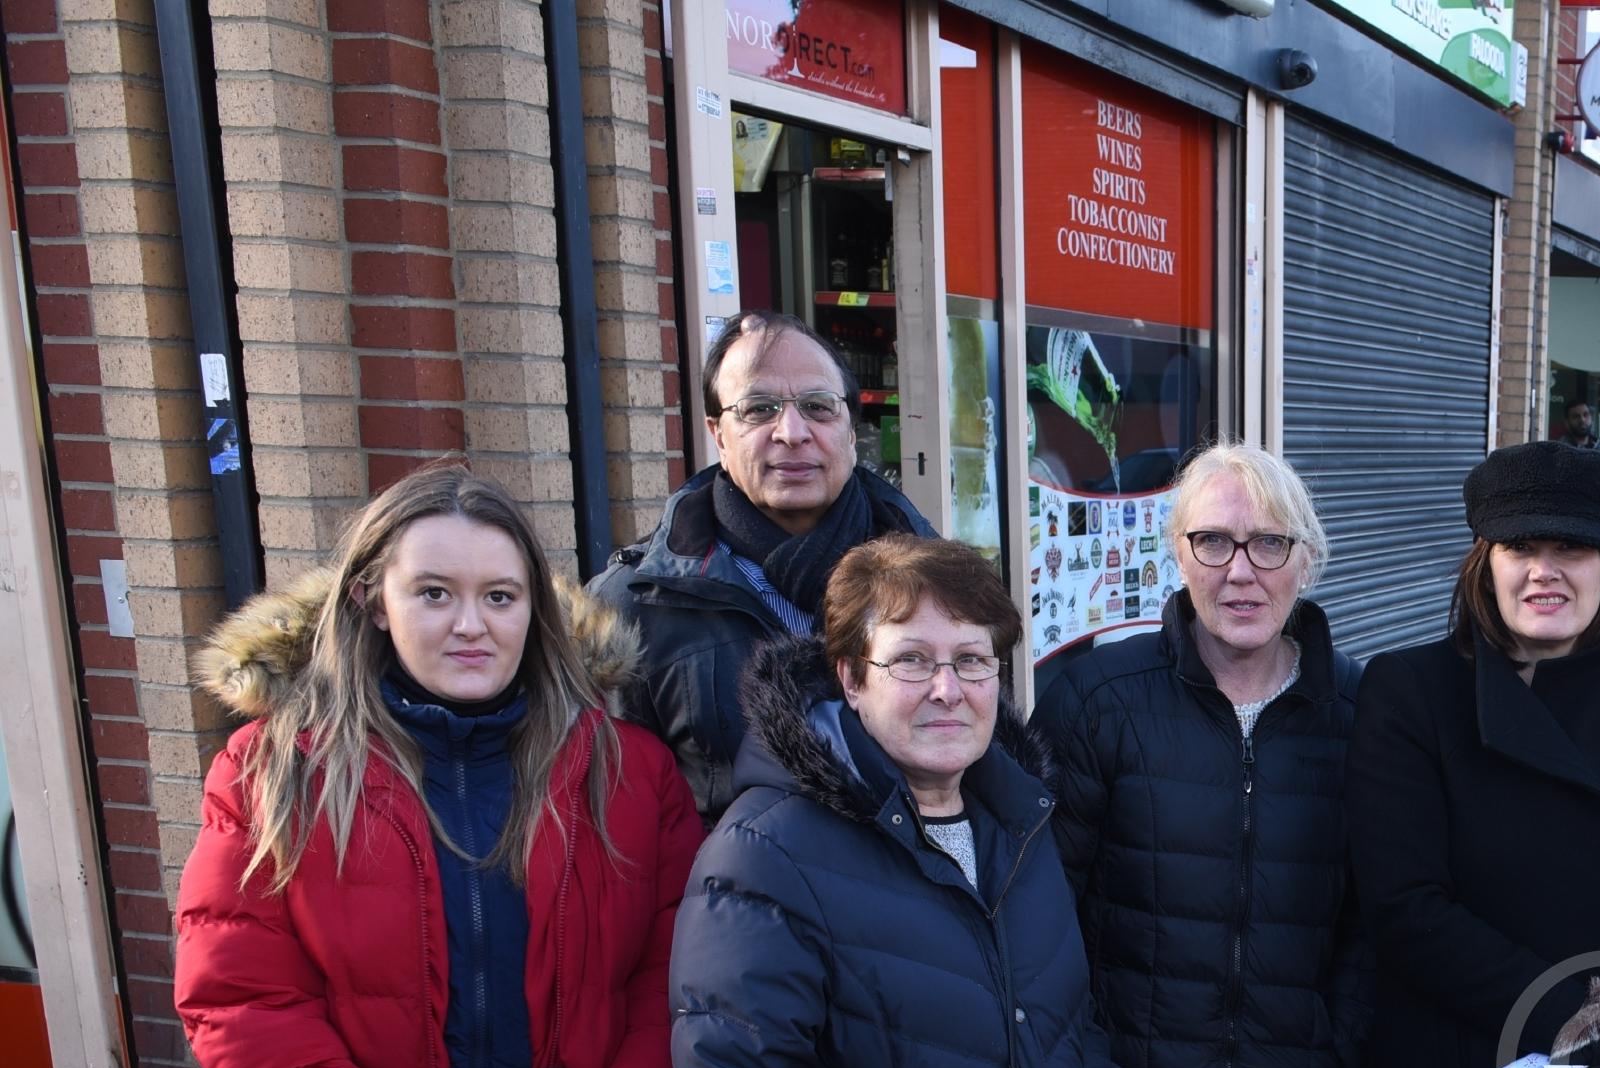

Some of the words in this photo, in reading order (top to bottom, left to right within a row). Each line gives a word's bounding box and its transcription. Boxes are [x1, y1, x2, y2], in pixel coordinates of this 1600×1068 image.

[1097, 99, 1142, 140] BEERS
[1096, 133, 1142, 172] WINES
[1093, 167, 1146, 205] SPIRITS
[1067, 193, 1168, 243] TOBACCONIST
[1057, 227, 1176, 276] CONFECTIONERY
